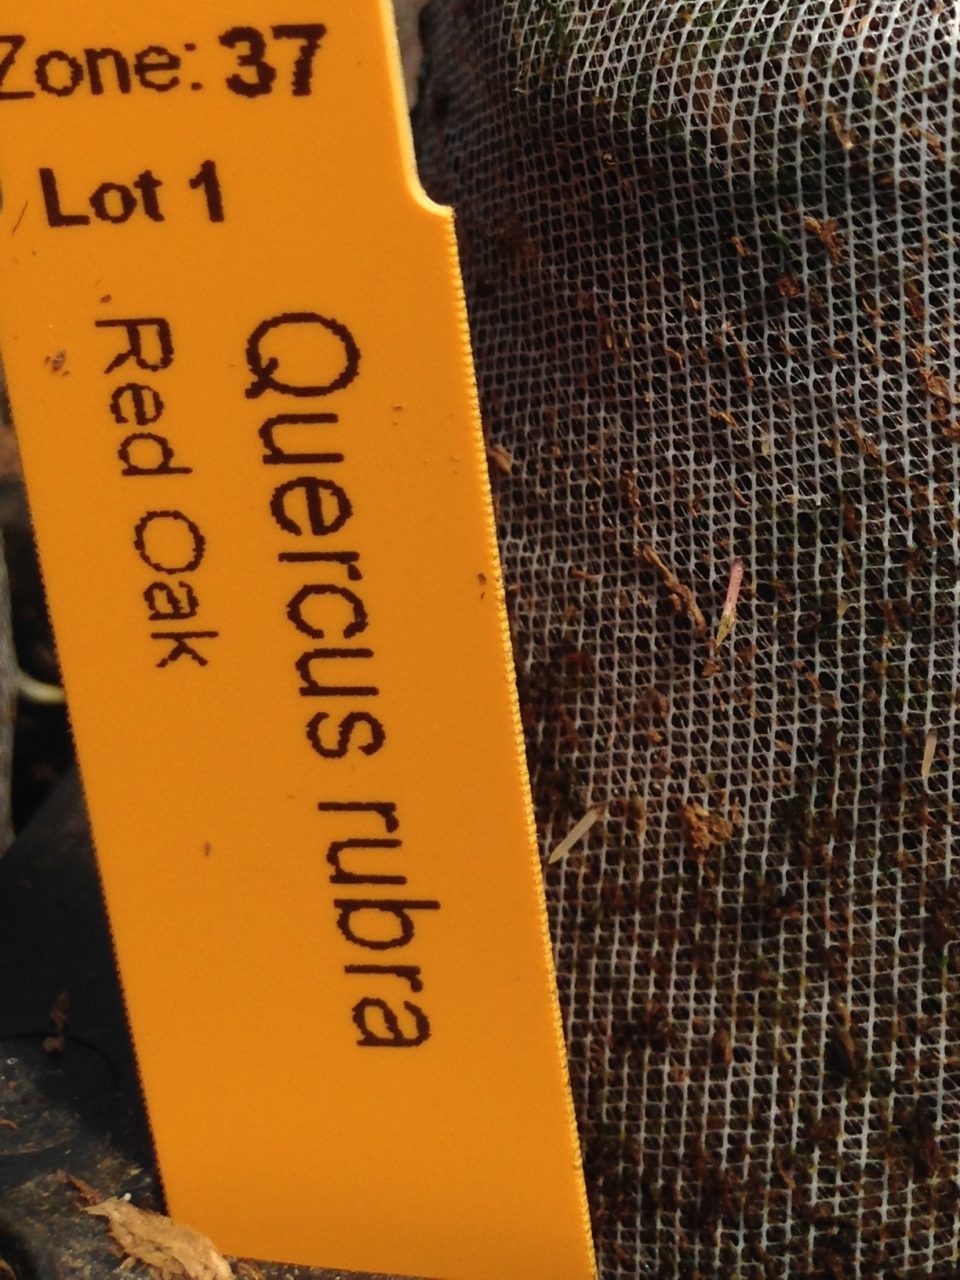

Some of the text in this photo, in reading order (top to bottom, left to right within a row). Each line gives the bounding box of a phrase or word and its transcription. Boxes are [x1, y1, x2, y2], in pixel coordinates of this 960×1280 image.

[0, 24, 326, 100] Zone: 37
[40, 160, 224, 227] Lot 1
[95, 318, 218, 667] Red Oak
[245, 312, 440, 1047] Quercus rubra
